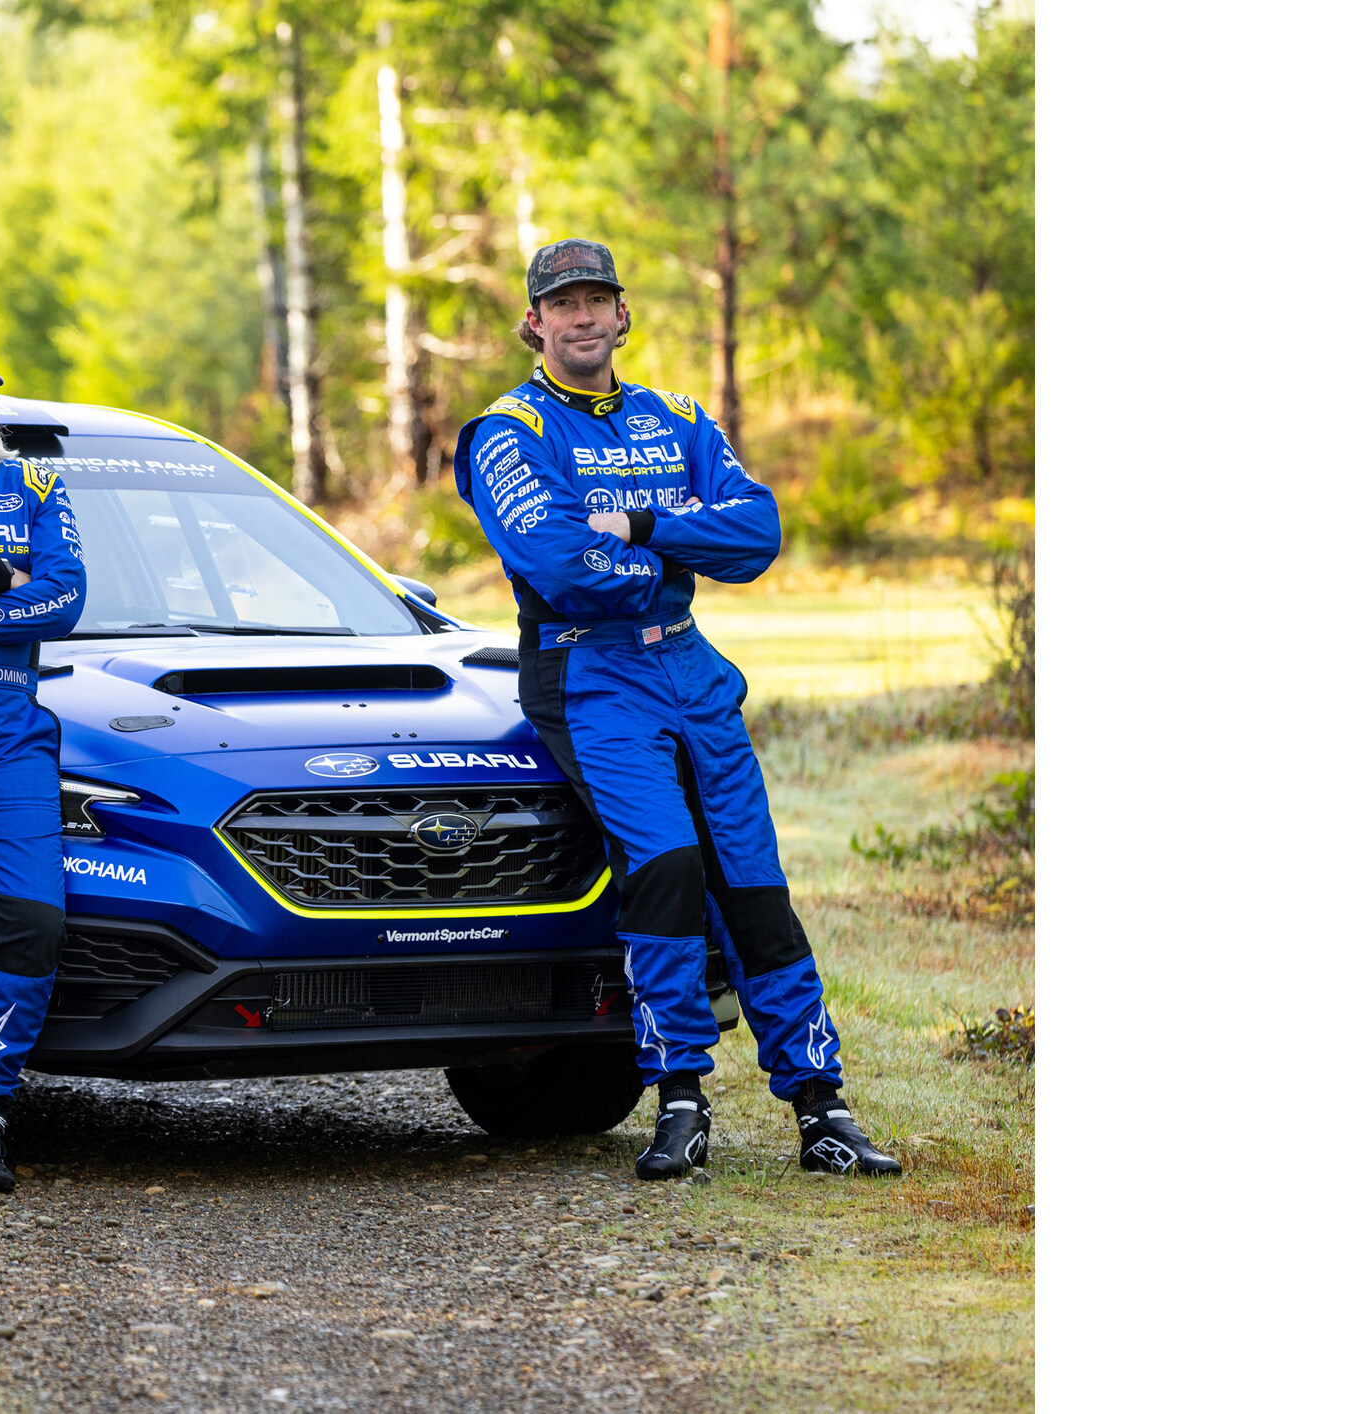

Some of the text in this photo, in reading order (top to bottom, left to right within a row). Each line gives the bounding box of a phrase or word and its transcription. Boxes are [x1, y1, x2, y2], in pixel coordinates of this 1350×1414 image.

[629, 427, 674, 441] SUBARU
[572, 441, 683, 467] SUBARU
[51, 465, 205, 478] SSOCIATION
[144, 460, 216, 472] RALLY
[577, 463, 685, 478] MOTORSPORTS USA
[492, 466, 530, 500] MOTUL
[496, 478, 539, 517] can-am
[615, 487, 684, 510] BLACK RIFLE
[8, 545, 30, 555] USA
[9, 587, 78, 620] SUBARU
[387, 752, 538, 769] SUBARU
[63, 856, 147, 885] KOHAMA
[386, 927, 504, 943] VermontSportsCar
